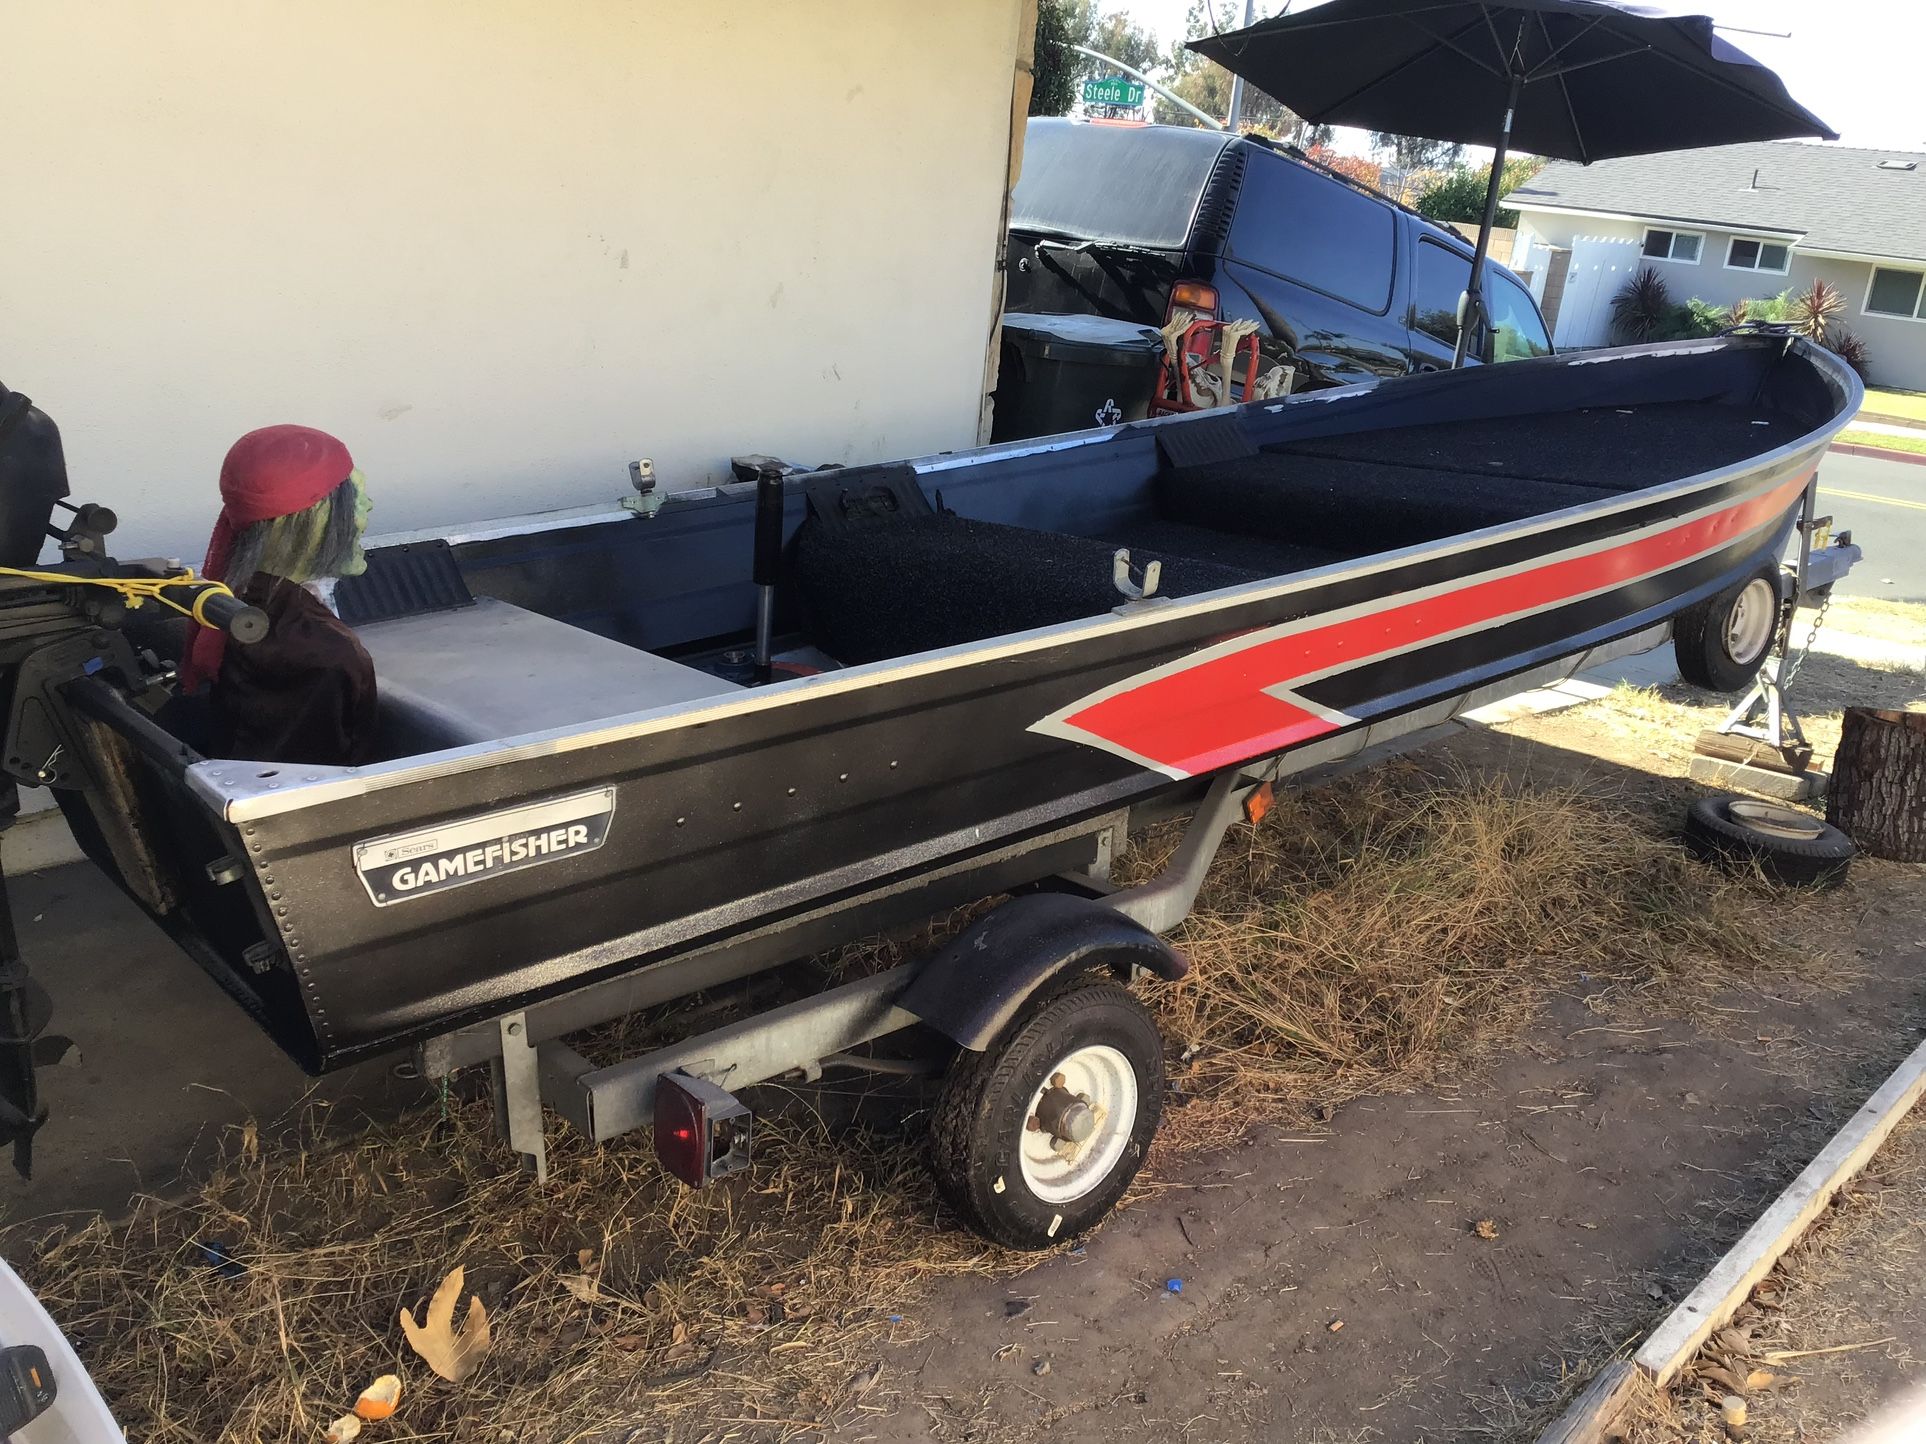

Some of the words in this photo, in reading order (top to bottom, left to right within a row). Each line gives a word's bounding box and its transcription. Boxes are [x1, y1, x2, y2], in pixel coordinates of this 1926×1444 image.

[1085, 83, 1121, 101] Steele
[1127, 86, 1142, 103] Dr
[401, 843, 434, 856] Sears
